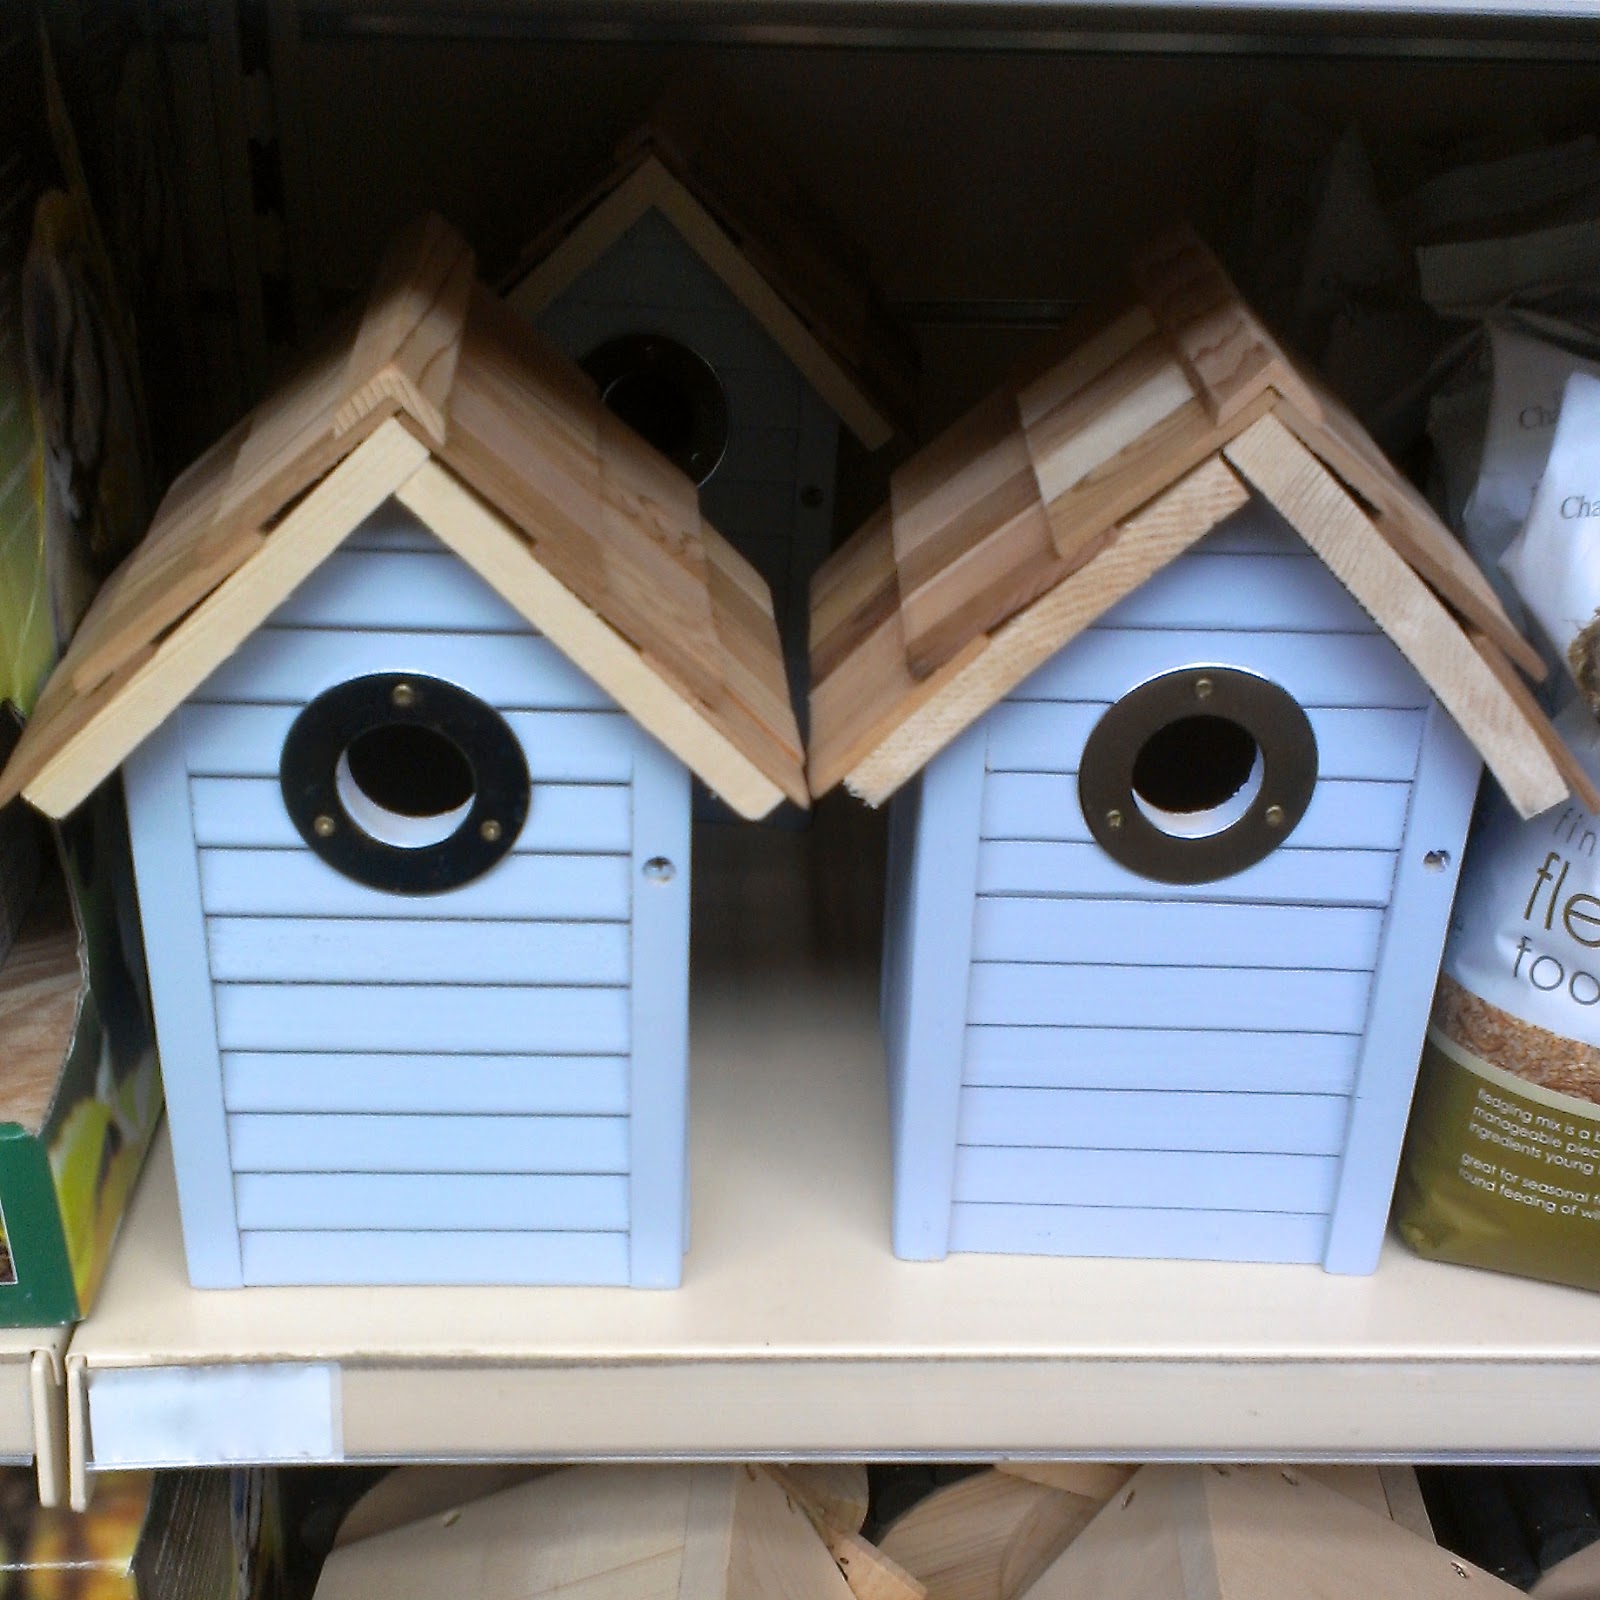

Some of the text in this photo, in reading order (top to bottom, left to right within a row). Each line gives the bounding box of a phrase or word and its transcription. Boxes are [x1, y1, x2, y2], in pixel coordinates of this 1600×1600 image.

[1524, 851, 1600, 948] fle
[1513, 935, 1600, 1006] foo
[1473, 1106, 1600, 1160] manageable piec
[1478, 1088, 1532, 1123] fledgling
[1536, 1115, 1561, 1132] mix
[1564, 1123, 1575, 1136] is
[1579, 1130, 1590, 1141] a
[1469, 1121, 1594, 1176] ingredients young
[1458, 1168, 1496, 1192] round
[1499, 1183, 1556, 1214] feeding
[1560, 1205, 1578, 1216] of
[1461, 1153, 1497, 1175] great
[1500, 1168, 1519, 1183] for
[1522, 1178, 1589, 1203] seasonal
